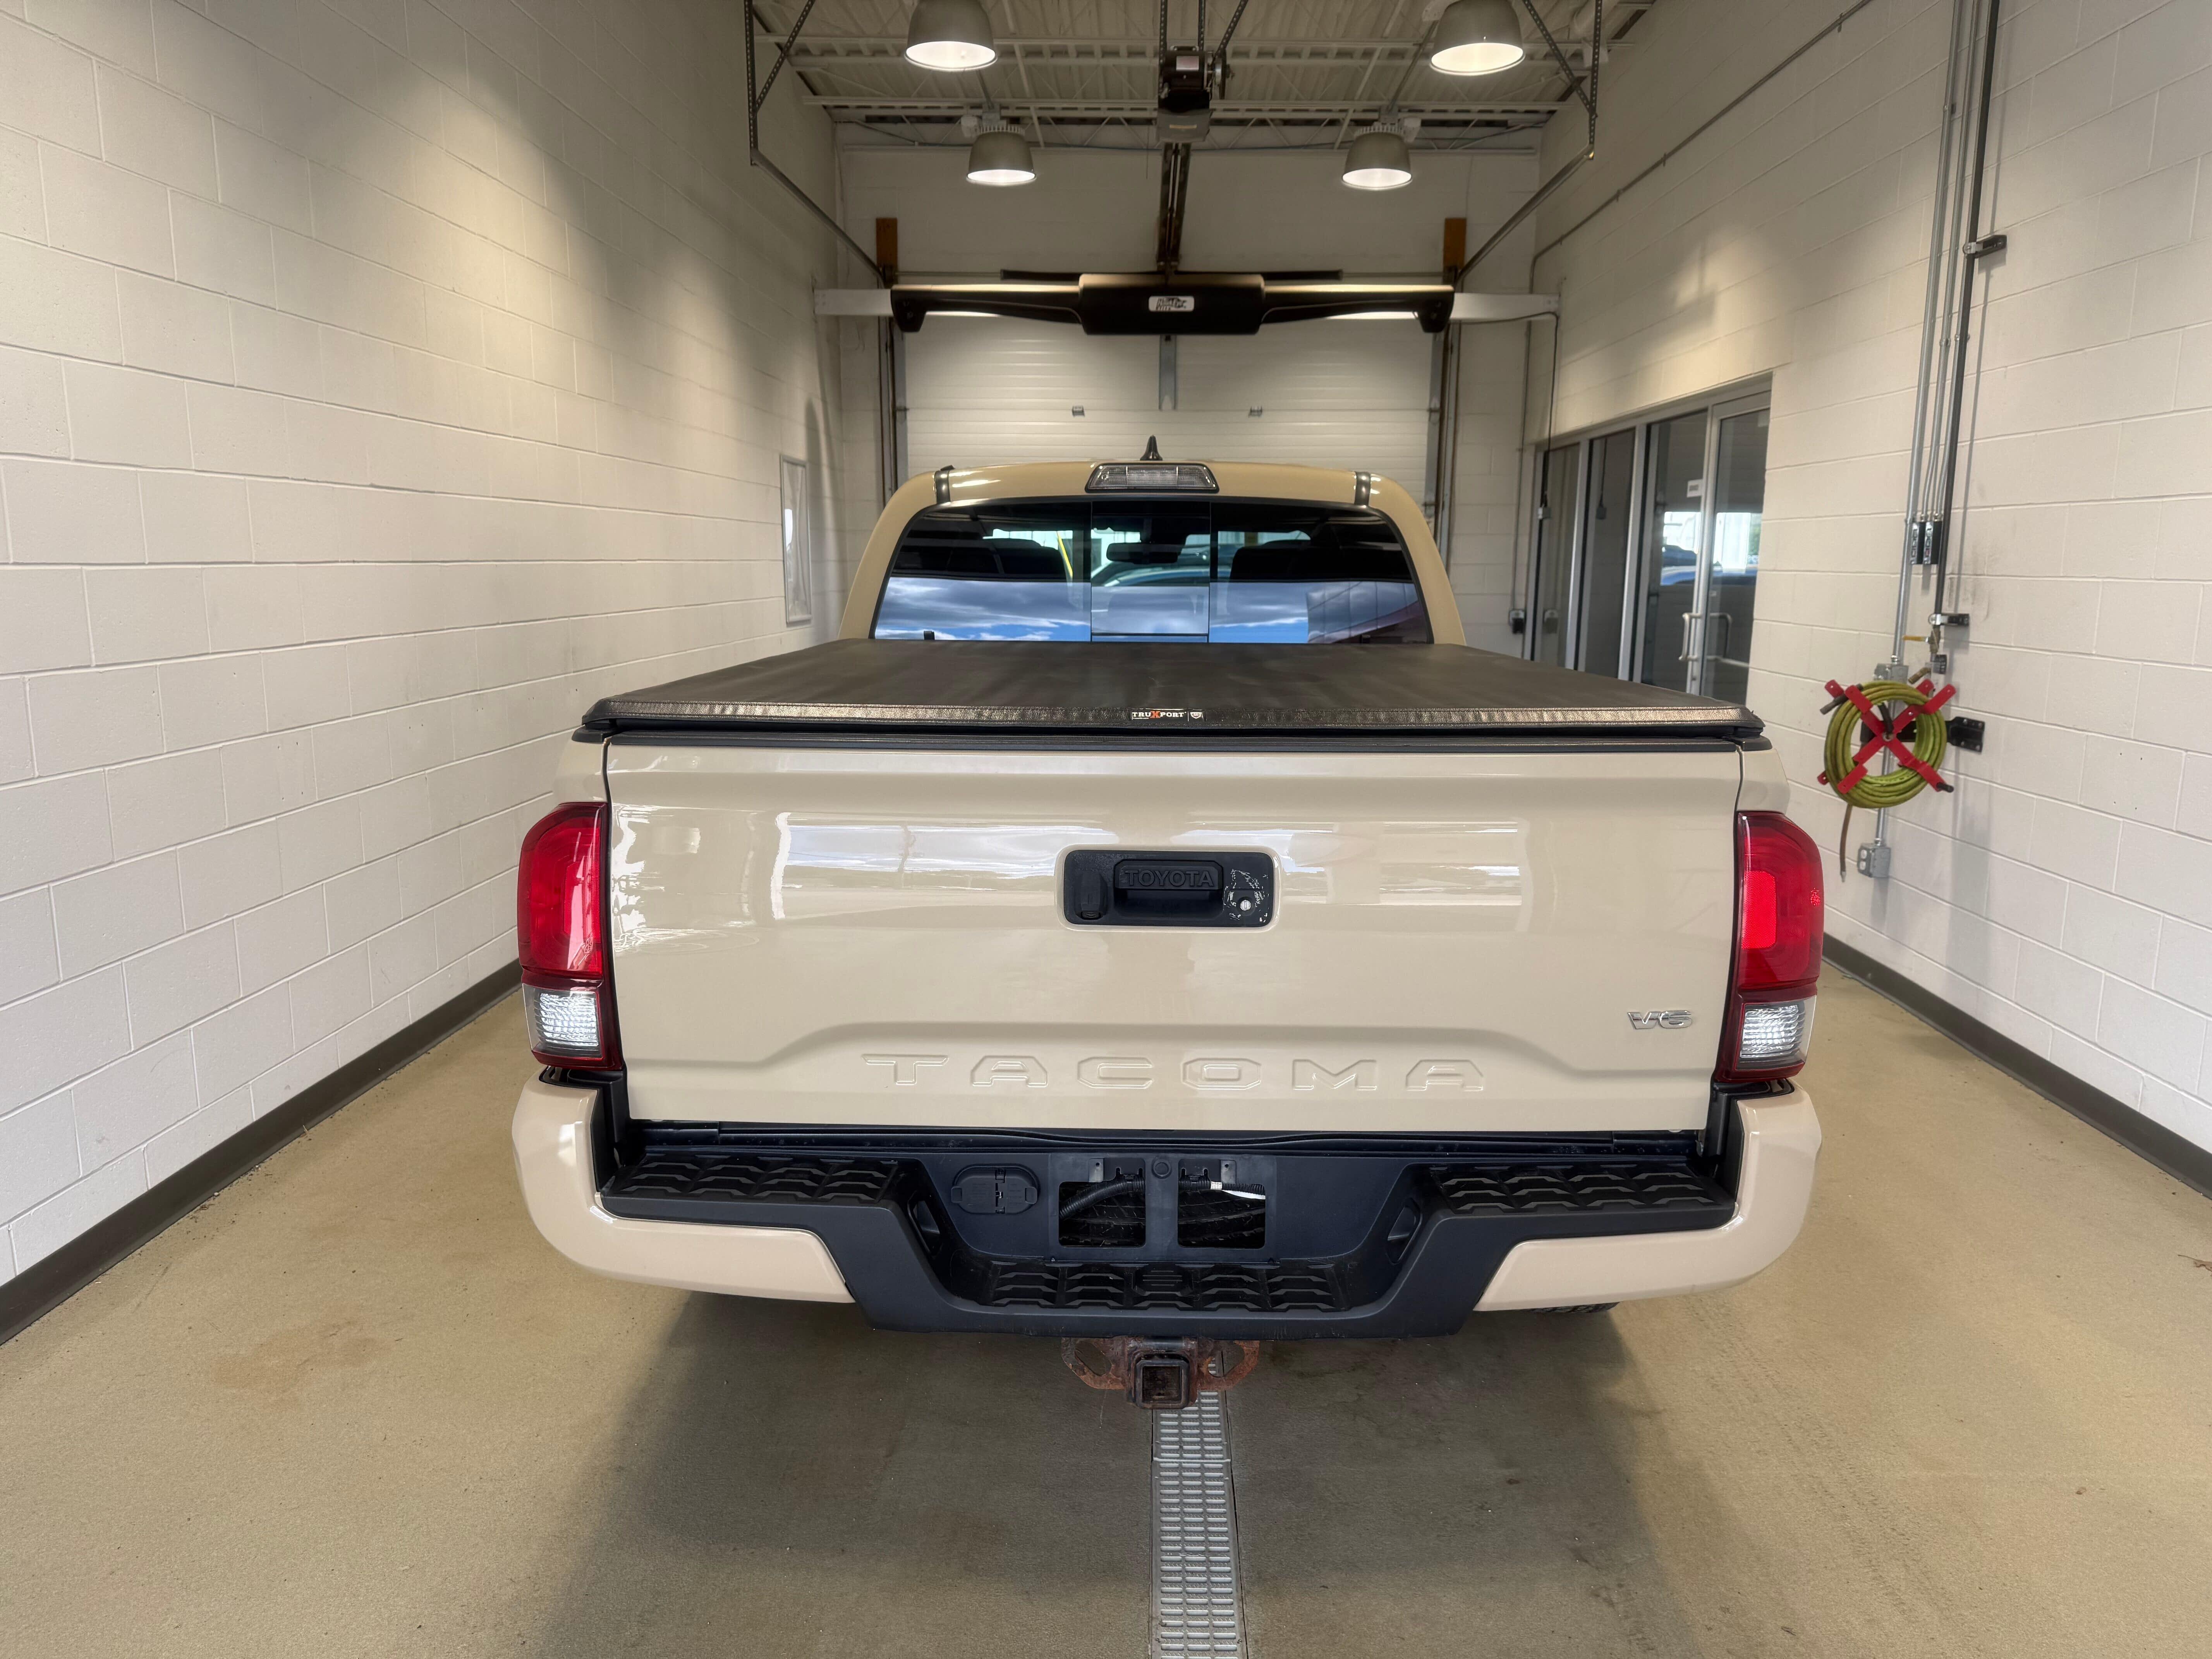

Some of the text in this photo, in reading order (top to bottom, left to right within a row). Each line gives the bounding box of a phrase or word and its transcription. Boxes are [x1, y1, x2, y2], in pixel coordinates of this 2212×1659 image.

[1125, 870, 1214, 886] TOYOTA
[1627, 1010, 1692, 1029] V6
[863, 1053, 1485, 1092] TACOMA
